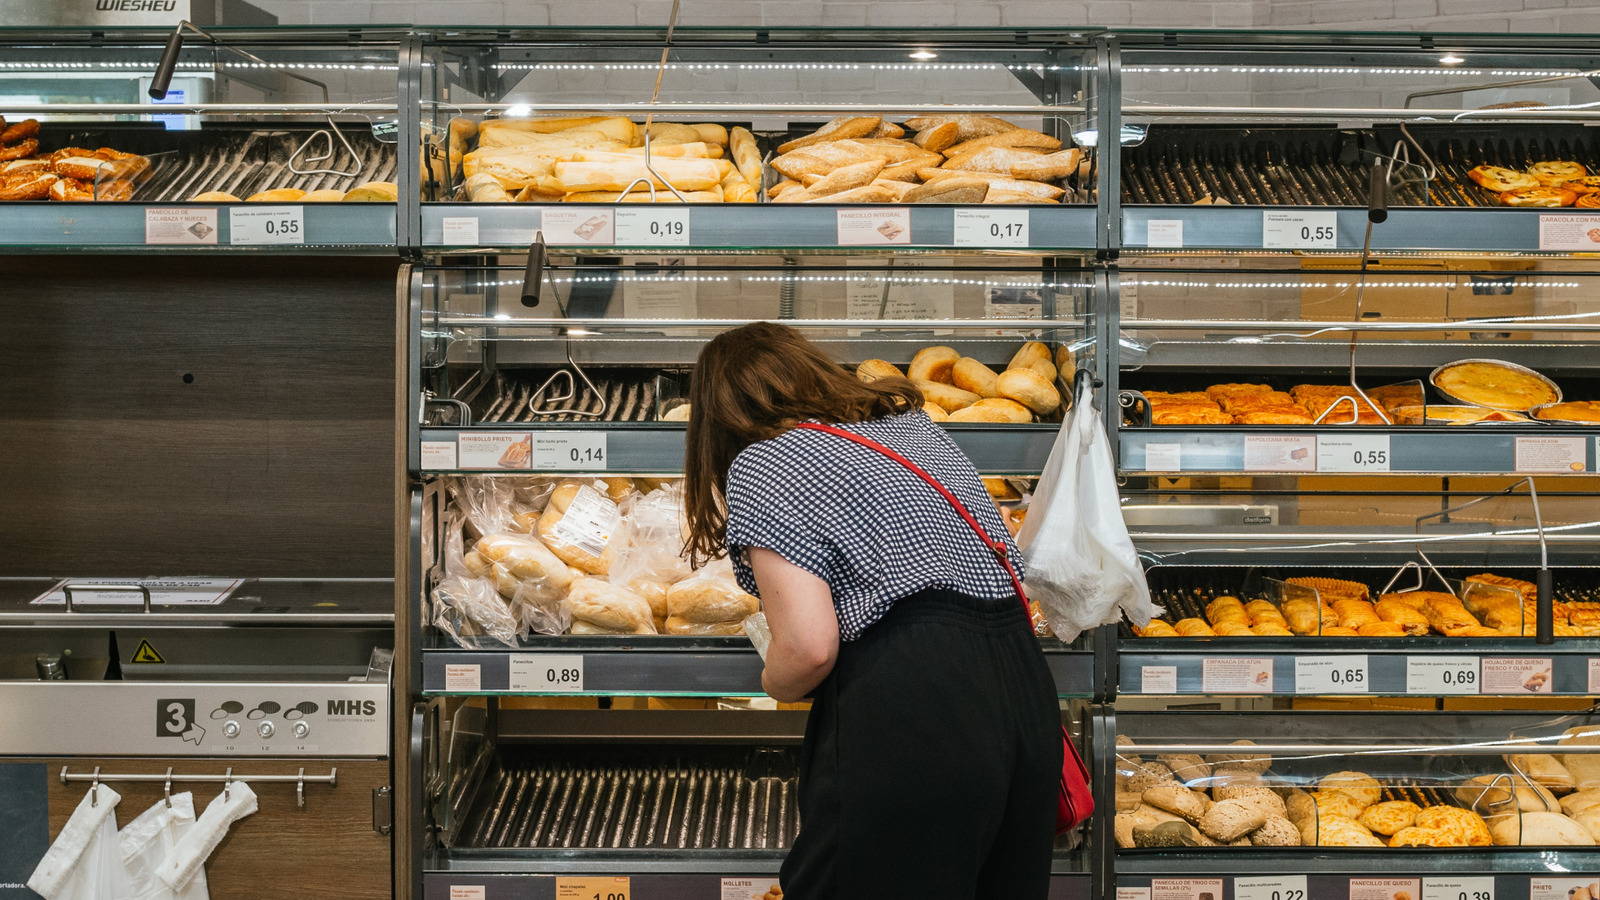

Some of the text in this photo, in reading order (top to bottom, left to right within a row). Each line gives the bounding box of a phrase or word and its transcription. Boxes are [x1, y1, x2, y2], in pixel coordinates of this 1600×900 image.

[96, 0, 176, 11] WIESHEU
[266, 220, 298, 235] 0,55
[650, 222, 683, 237] 0,19
[990, 223, 1023, 239] 0,17
[1301, 226, 1333, 242] 0,55
[570, 448, 603, 463] 0,14
[1354, 451, 1386, 466] 0,55
[547, 669, 579, 684] 0,89
[1332, 669, 1363, 685] 0,65
[1443, 671, 1475, 686] 0,69
[327, 700, 376, 716] MHS
[166, 702, 186, 732] 3
[1272, 890, 1303, 900] 022
[1459, 892, 1490, 900] 039
